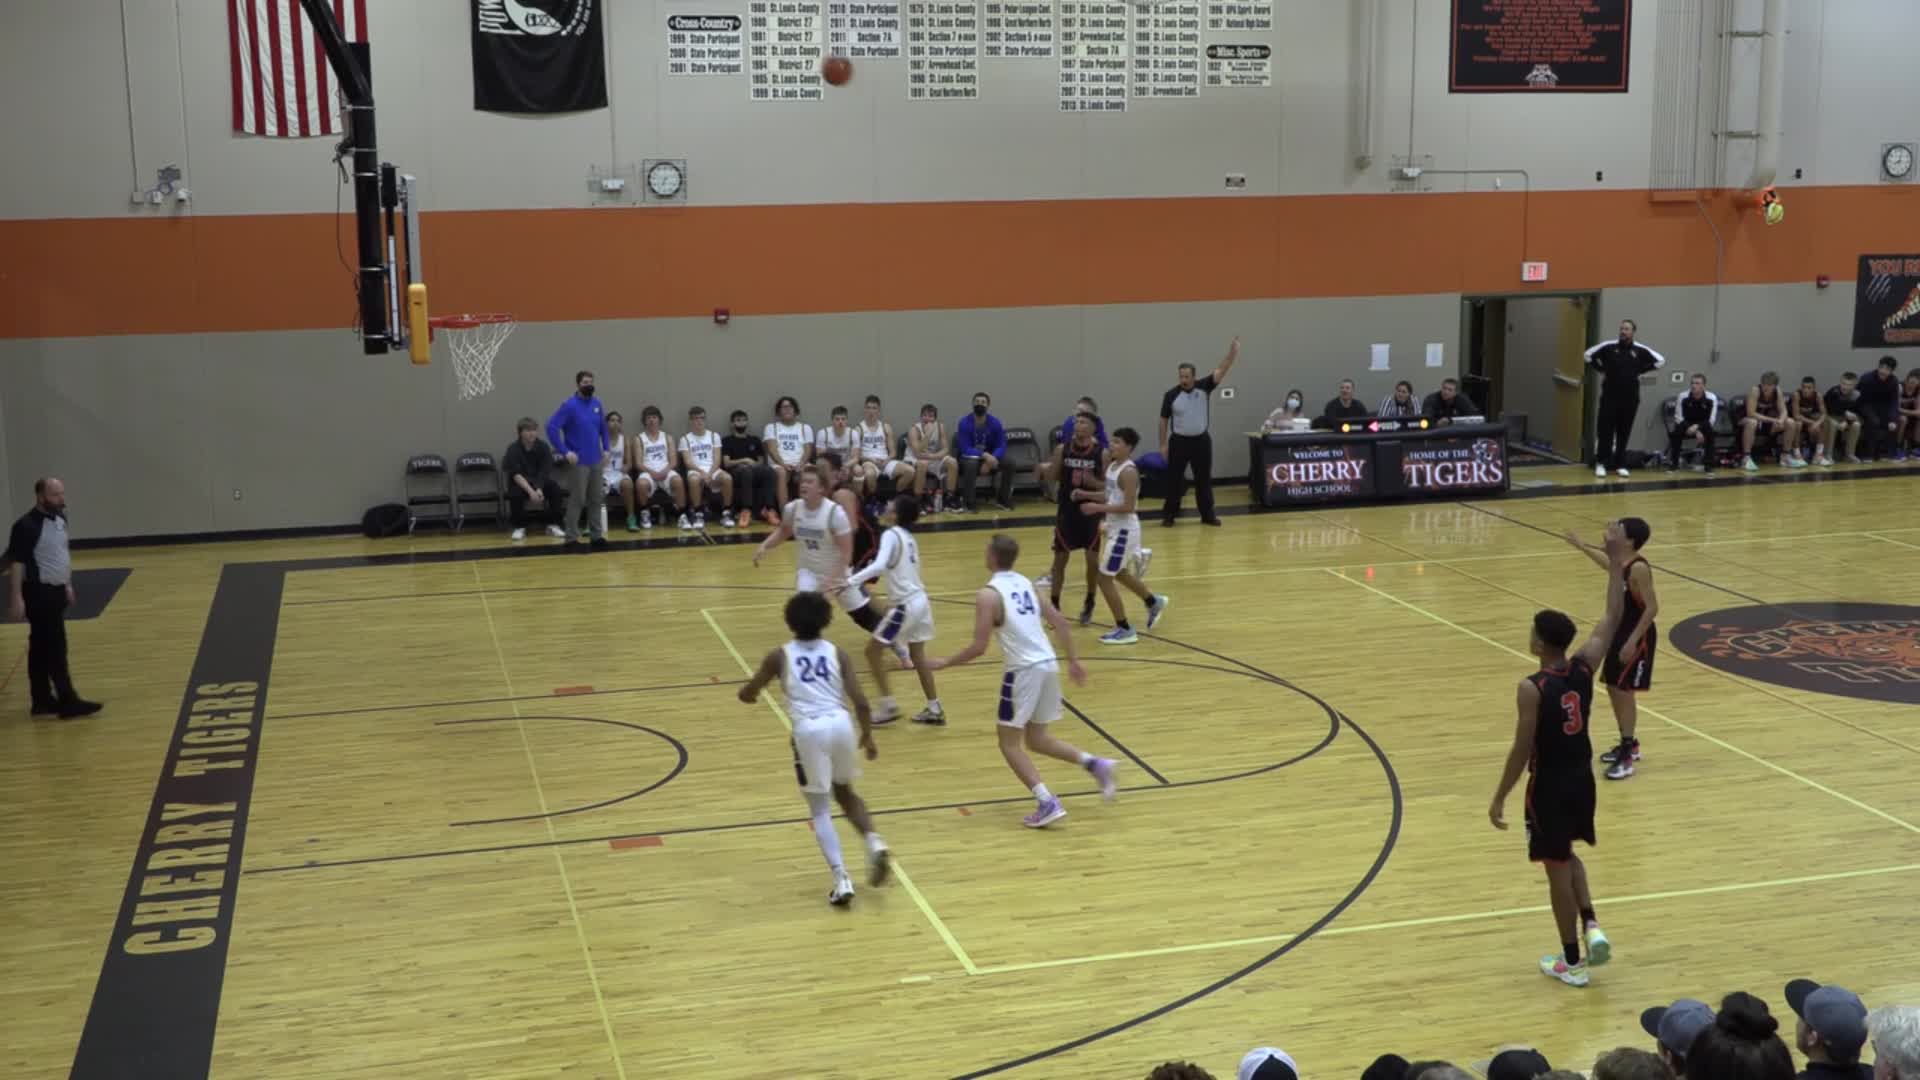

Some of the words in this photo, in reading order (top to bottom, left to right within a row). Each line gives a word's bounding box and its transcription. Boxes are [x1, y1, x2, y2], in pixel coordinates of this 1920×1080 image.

[780, 3, 795, 12] Louis
[798, 3, 819, 14] County
[850, 5, 864, 14] State
[867, 5, 898, 15] Participant
[937, 5, 952, 13] Louis
[955, 5, 976, 15] County
[1088, 4, 1104, 13] Louis
[1106, 4, 1125, 15] County
[1162, 5, 1176, 14] Louis
[1179, 5, 1198, 15] County
[778, 18, 801, 27] District
[804, 18, 812, 27] 27
[831, 19, 845, 28] 2011
[859, 19, 875, 28] Louis
[877, 19, 898, 29] County
[937, 18, 952, 27] Louis
[955, 18, 976, 29] County
[1088, 18, 1104, 27] Louis
[1106, 18, 1125, 29] County
[1162, 19, 1176, 28] Louis
[1179, 19, 1198, 29] County
[690, 34, 705, 44] State
[708, 34, 740, 44] Participant
[778, 32, 801, 41] District
[805, 32, 812, 41] 27
[831, 32, 846, 42] 2011
[858, 32, 880, 42] Section
[929, 32, 950, 41] Section
[1005, 32, 1026, 41] Section
[1162, 32, 1176, 41] Louis
[1179, 32, 1198, 43] County
[690, 48, 705, 58] State
[708, 48, 740, 58] Participant
[781, 46, 796, 56] Louis
[800, 46, 820, 57] County
[851, 47, 865, 56] State
[867, 47, 898, 57] Participant
[929, 46, 943, 56] State
[946, 46, 976, 57] Participant
[1005, 46, 1018, 55] State
[1021, 46, 1051, 56] Participant
[1087, 46, 1108, 54] Section
[1162, 46, 1176, 55] Louis
[1179, 46, 1197, 57] County
[1237, 47, 1260, 58] Sports
[671, 63, 686, 72] 2001
[691, 63, 706, 72] State
[708, 63, 741, 73] Participant
[779, 60, 802, 69] District
[805, 60, 813, 69] 27
[929, 60, 960, 69] Arrowhead
[1080, 60, 1094, 68] State
[1096, 60, 1125, 69] Participant
[1161, 60, 1176, 68] Louis
[1179, 60, 1197, 70] County
[781, 74, 797, 83] Louis
[800, 74, 820, 85] County
[937, 74, 953, 83] Louis
[956, 74, 976, 85] County
[1088, 73, 1103, 82] Louis
[1106, 73, 1125, 84] County
[1161, 74, 1176, 82] Louis
[1178, 74, 1197, 83] County
[782, 88, 798, 97] Louis
[800, 88, 821, 99] County
[1088, 87, 1103, 96] Louis
[1106, 87, 1125, 98] County
[1088, 101, 1103, 110] Louis
[1106, 101, 1125, 111] County
[1294, 451, 1330, 460] WELCOME
[1410, 451, 1435, 460] HOME
[1438, 450, 1450, 459] OF
[1452, 450, 1469, 458] THE
[1272, 460, 1366, 484] CHERRY
[1404, 461, 1503, 487] TIGERS
[1288, 487, 1312, 496] HIGH
[1314, 485, 1352, 494] SCHOOL
[1011, 590, 1035, 616] 34
[796, 656, 830, 682] 24
[1561, 690, 1583, 735] 3
[174, 681, 259, 777] TIGERS
[124, 802, 238, 955] CHERRY
